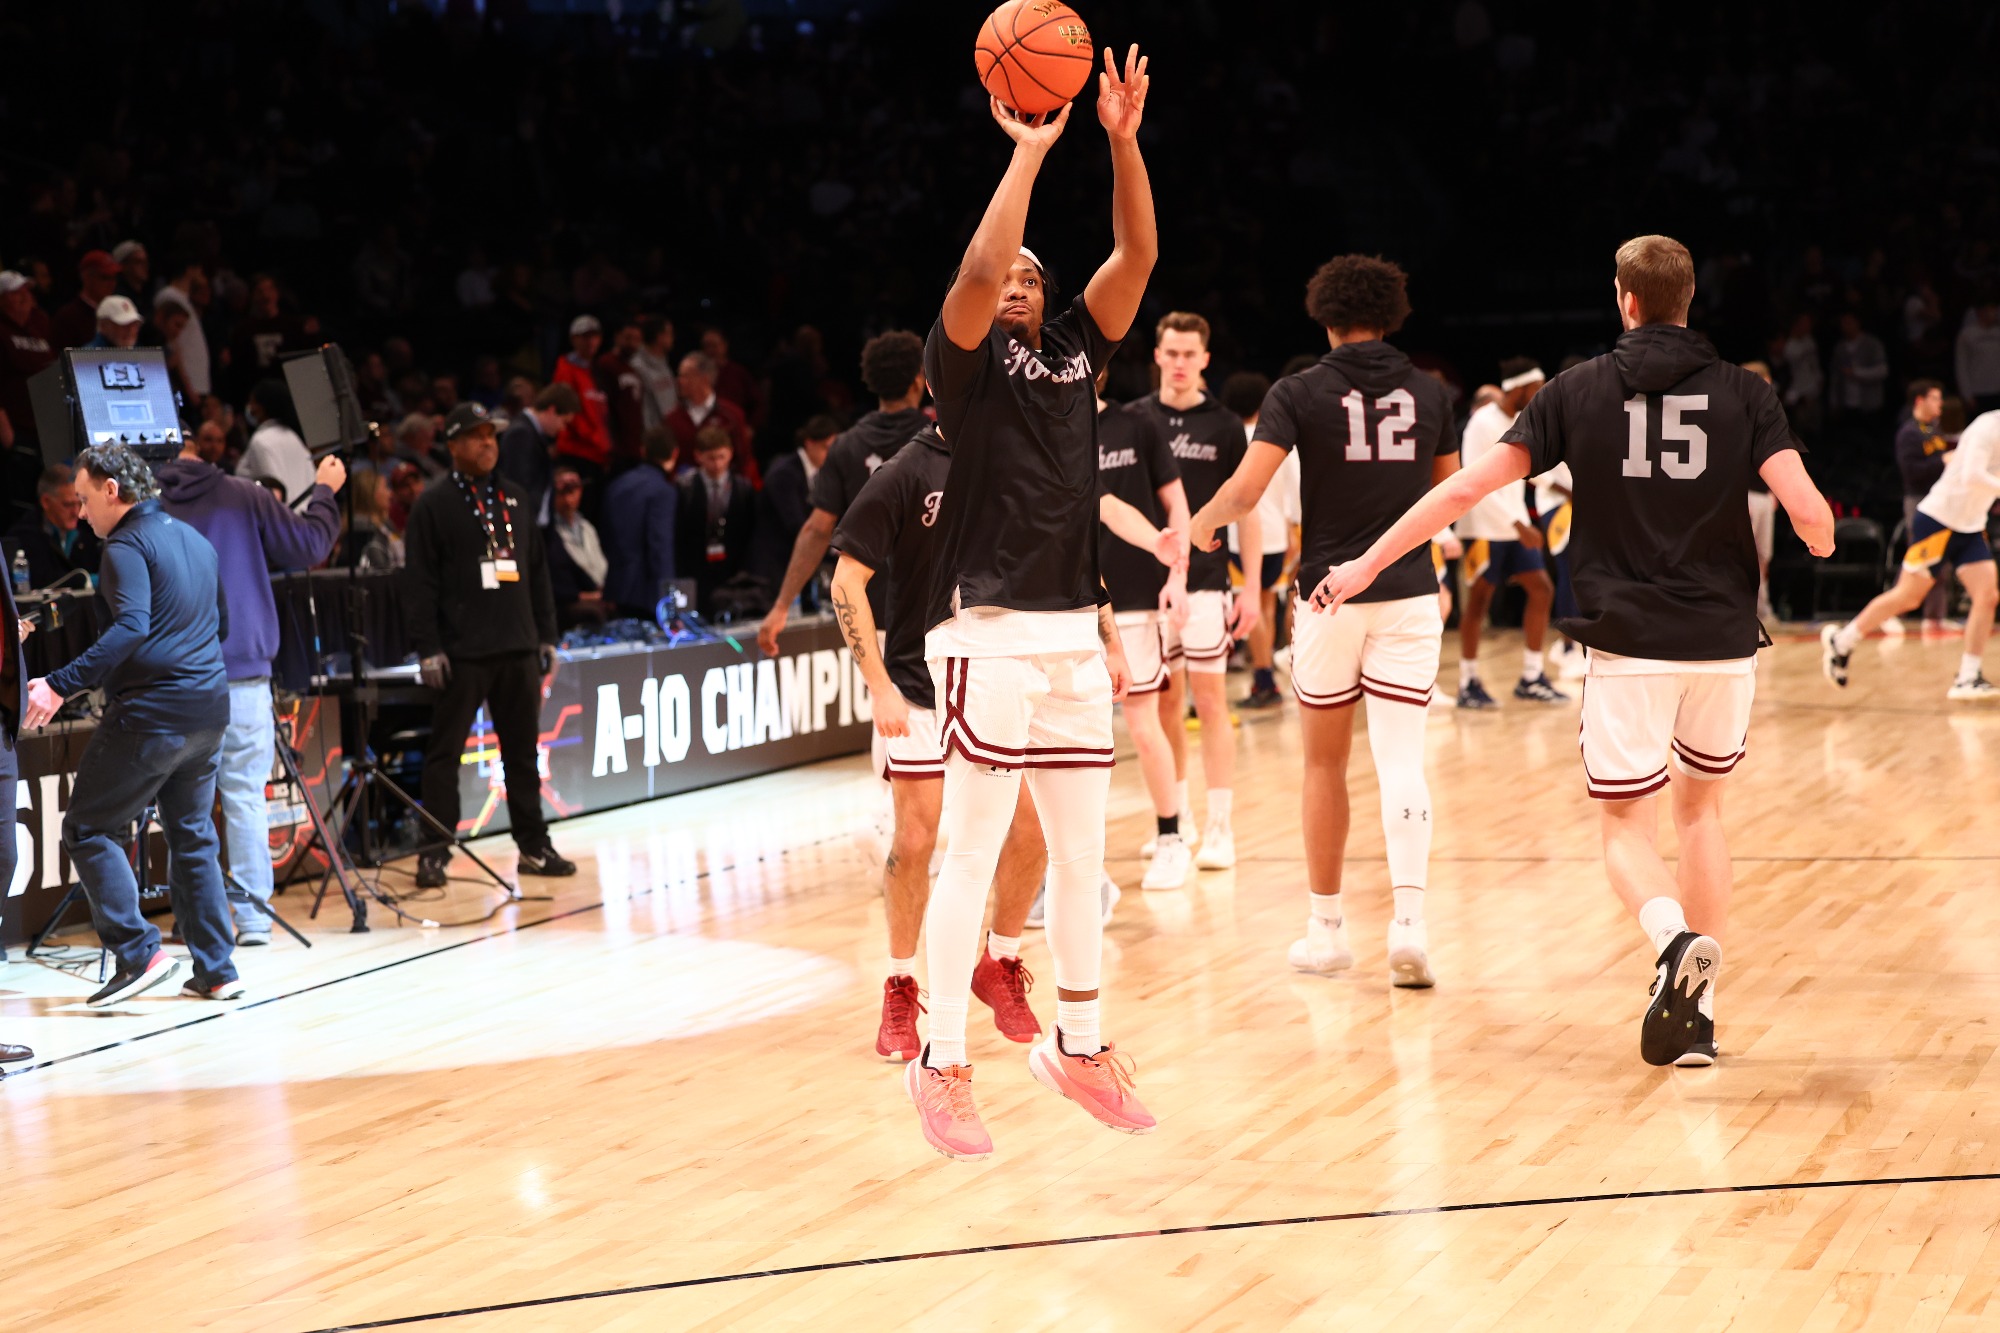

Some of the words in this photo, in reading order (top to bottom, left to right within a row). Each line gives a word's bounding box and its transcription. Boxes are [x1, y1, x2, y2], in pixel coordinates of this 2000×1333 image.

[1341, 388, 1417, 461] 12
[1622, 392, 1709, 480] 15
[592, 673, 692, 777] A-10
